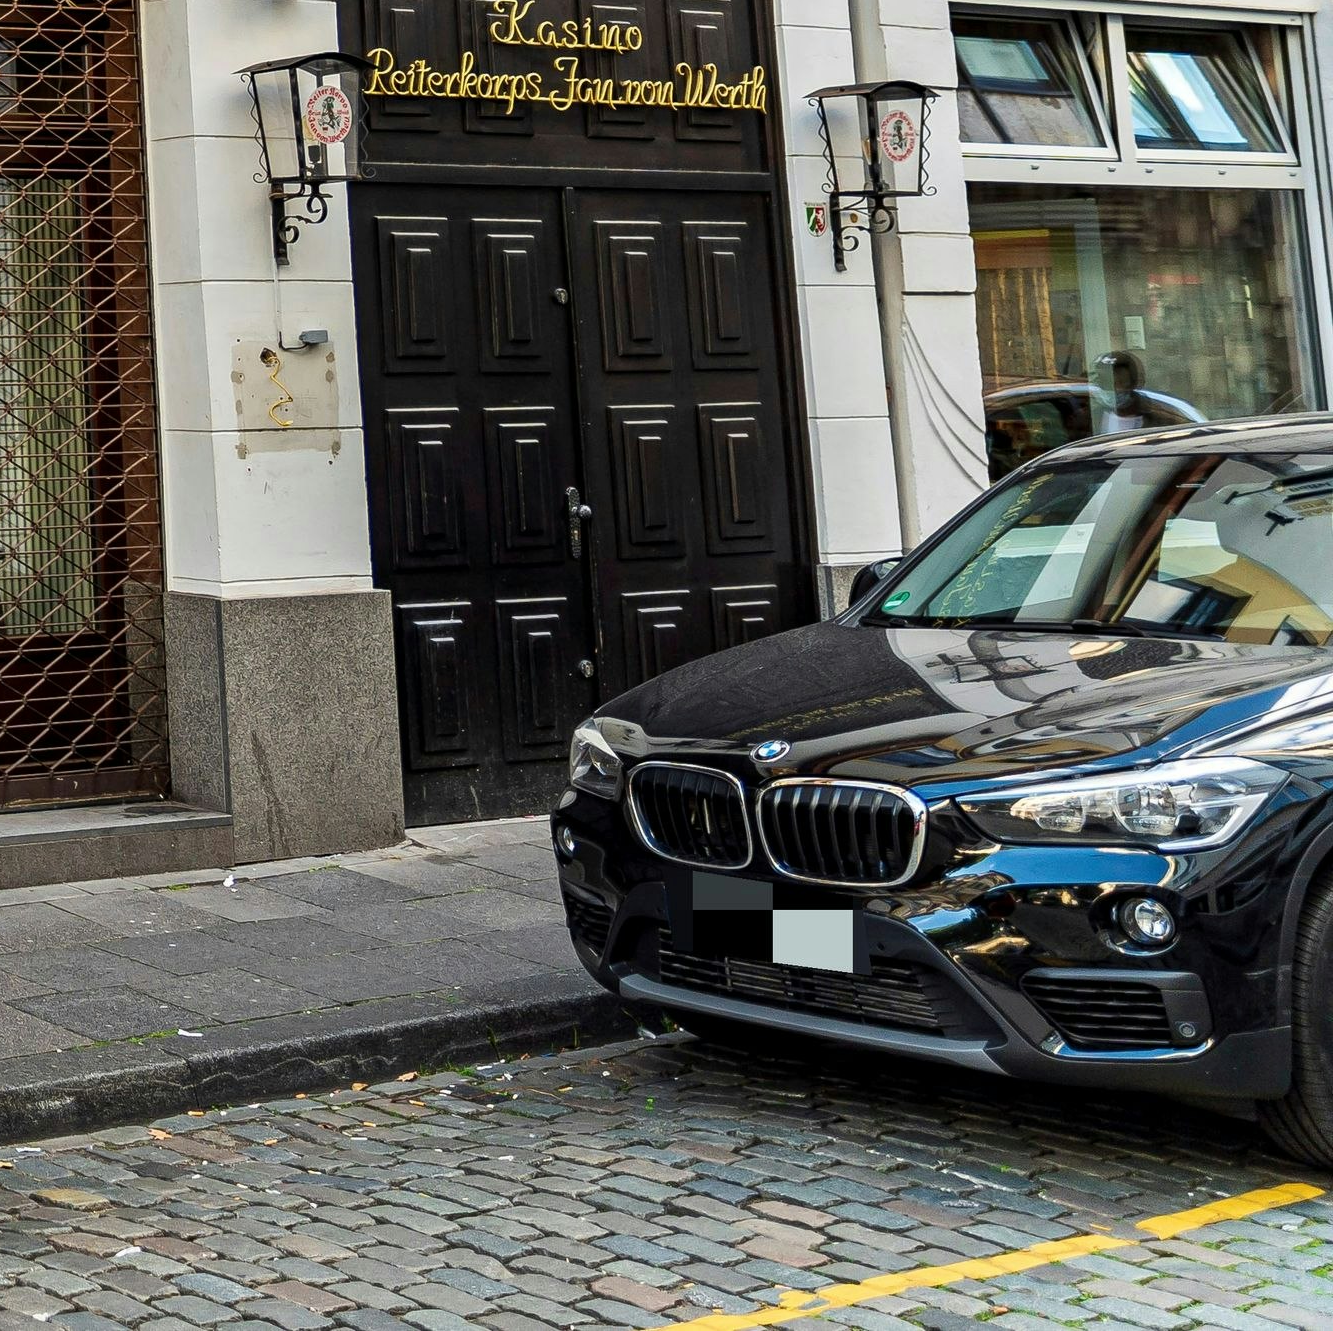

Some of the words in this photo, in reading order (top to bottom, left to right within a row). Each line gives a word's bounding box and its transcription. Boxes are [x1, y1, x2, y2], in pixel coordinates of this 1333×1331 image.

[362, 47, 542, 115] Reiterkorps
[550, 56, 618, 112] Jan
[621, 79, 677, 112] von
[675, 61, 769, 115] Werth
